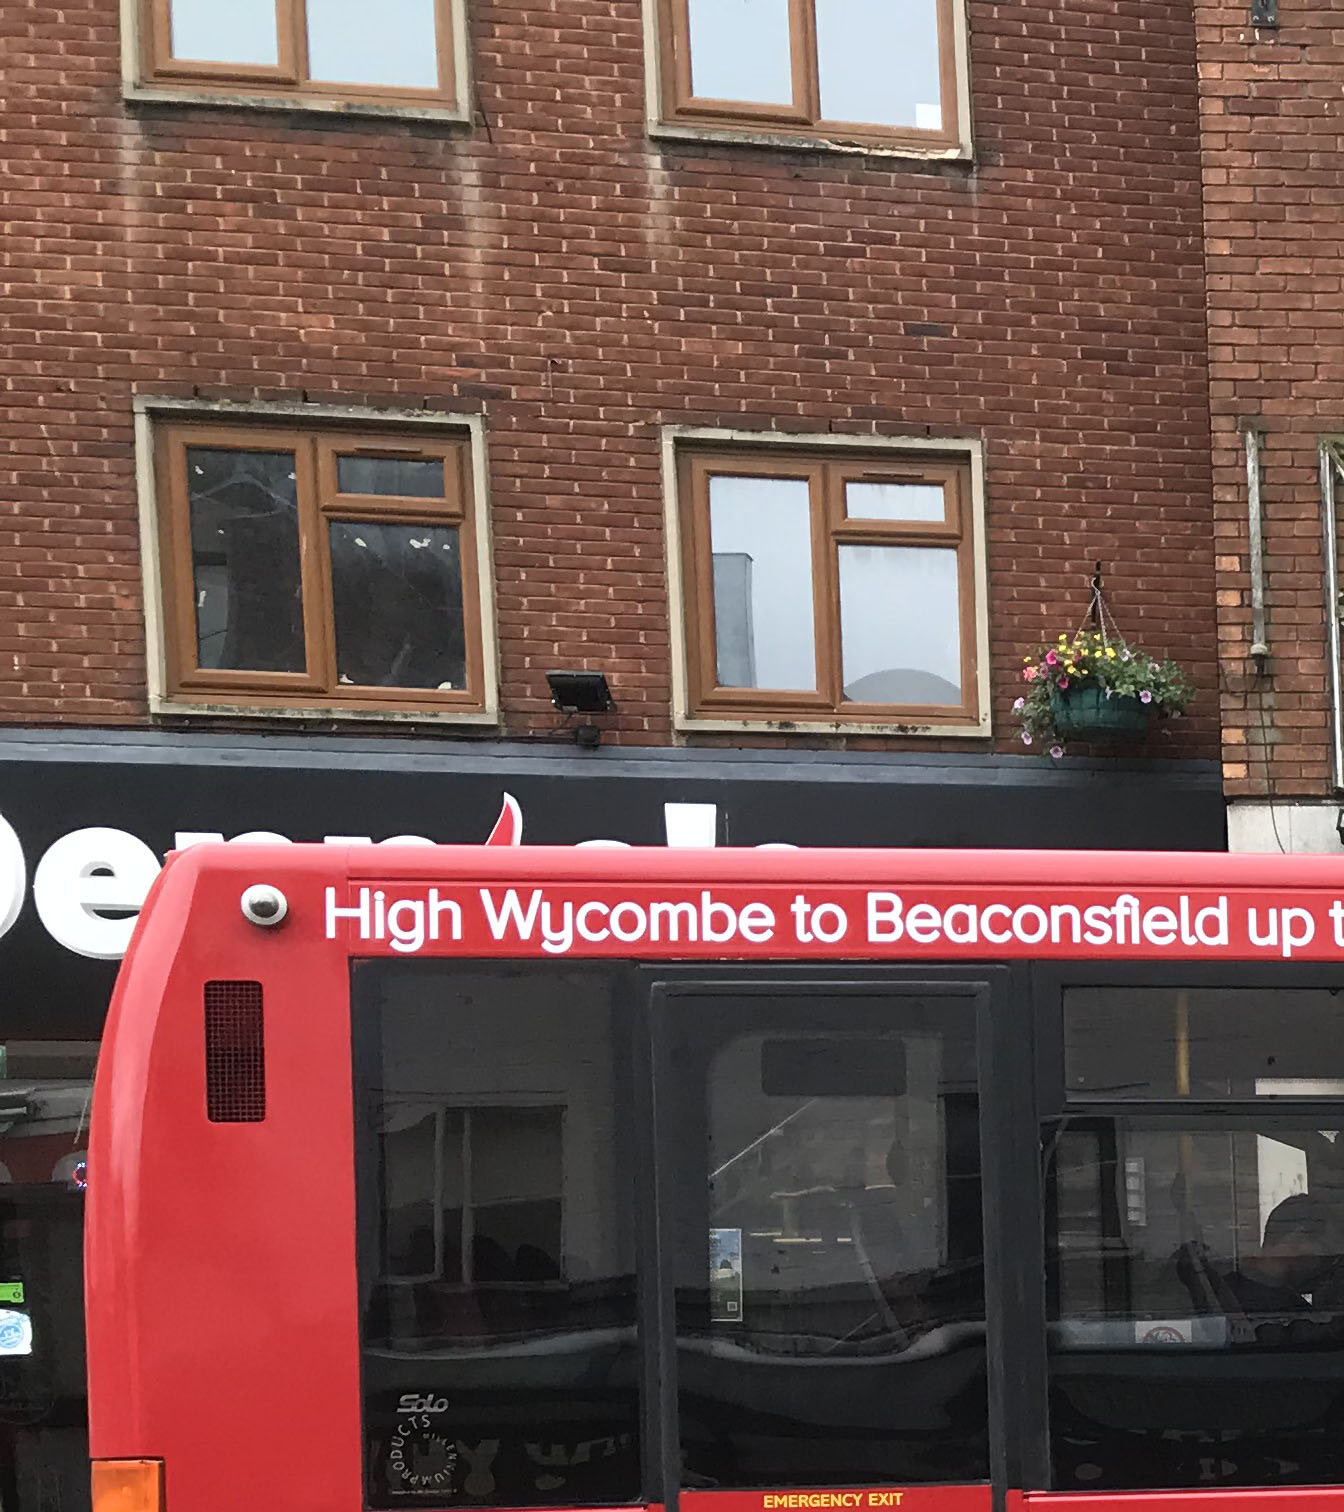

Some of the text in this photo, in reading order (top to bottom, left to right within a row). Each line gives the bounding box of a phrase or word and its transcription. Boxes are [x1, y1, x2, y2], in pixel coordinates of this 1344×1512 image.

[325, 887, 462, 953] High
[480, 888, 774, 954] Wycombe
[790, 895, 848, 943] to
[867, 892, 1228, 945] Beaconsfield
[1247, 907, 1315, 956] up
[397, 1394, 449, 1412] Solo
[763, 1492, 903, 1508] EMERGENCY EXIT
